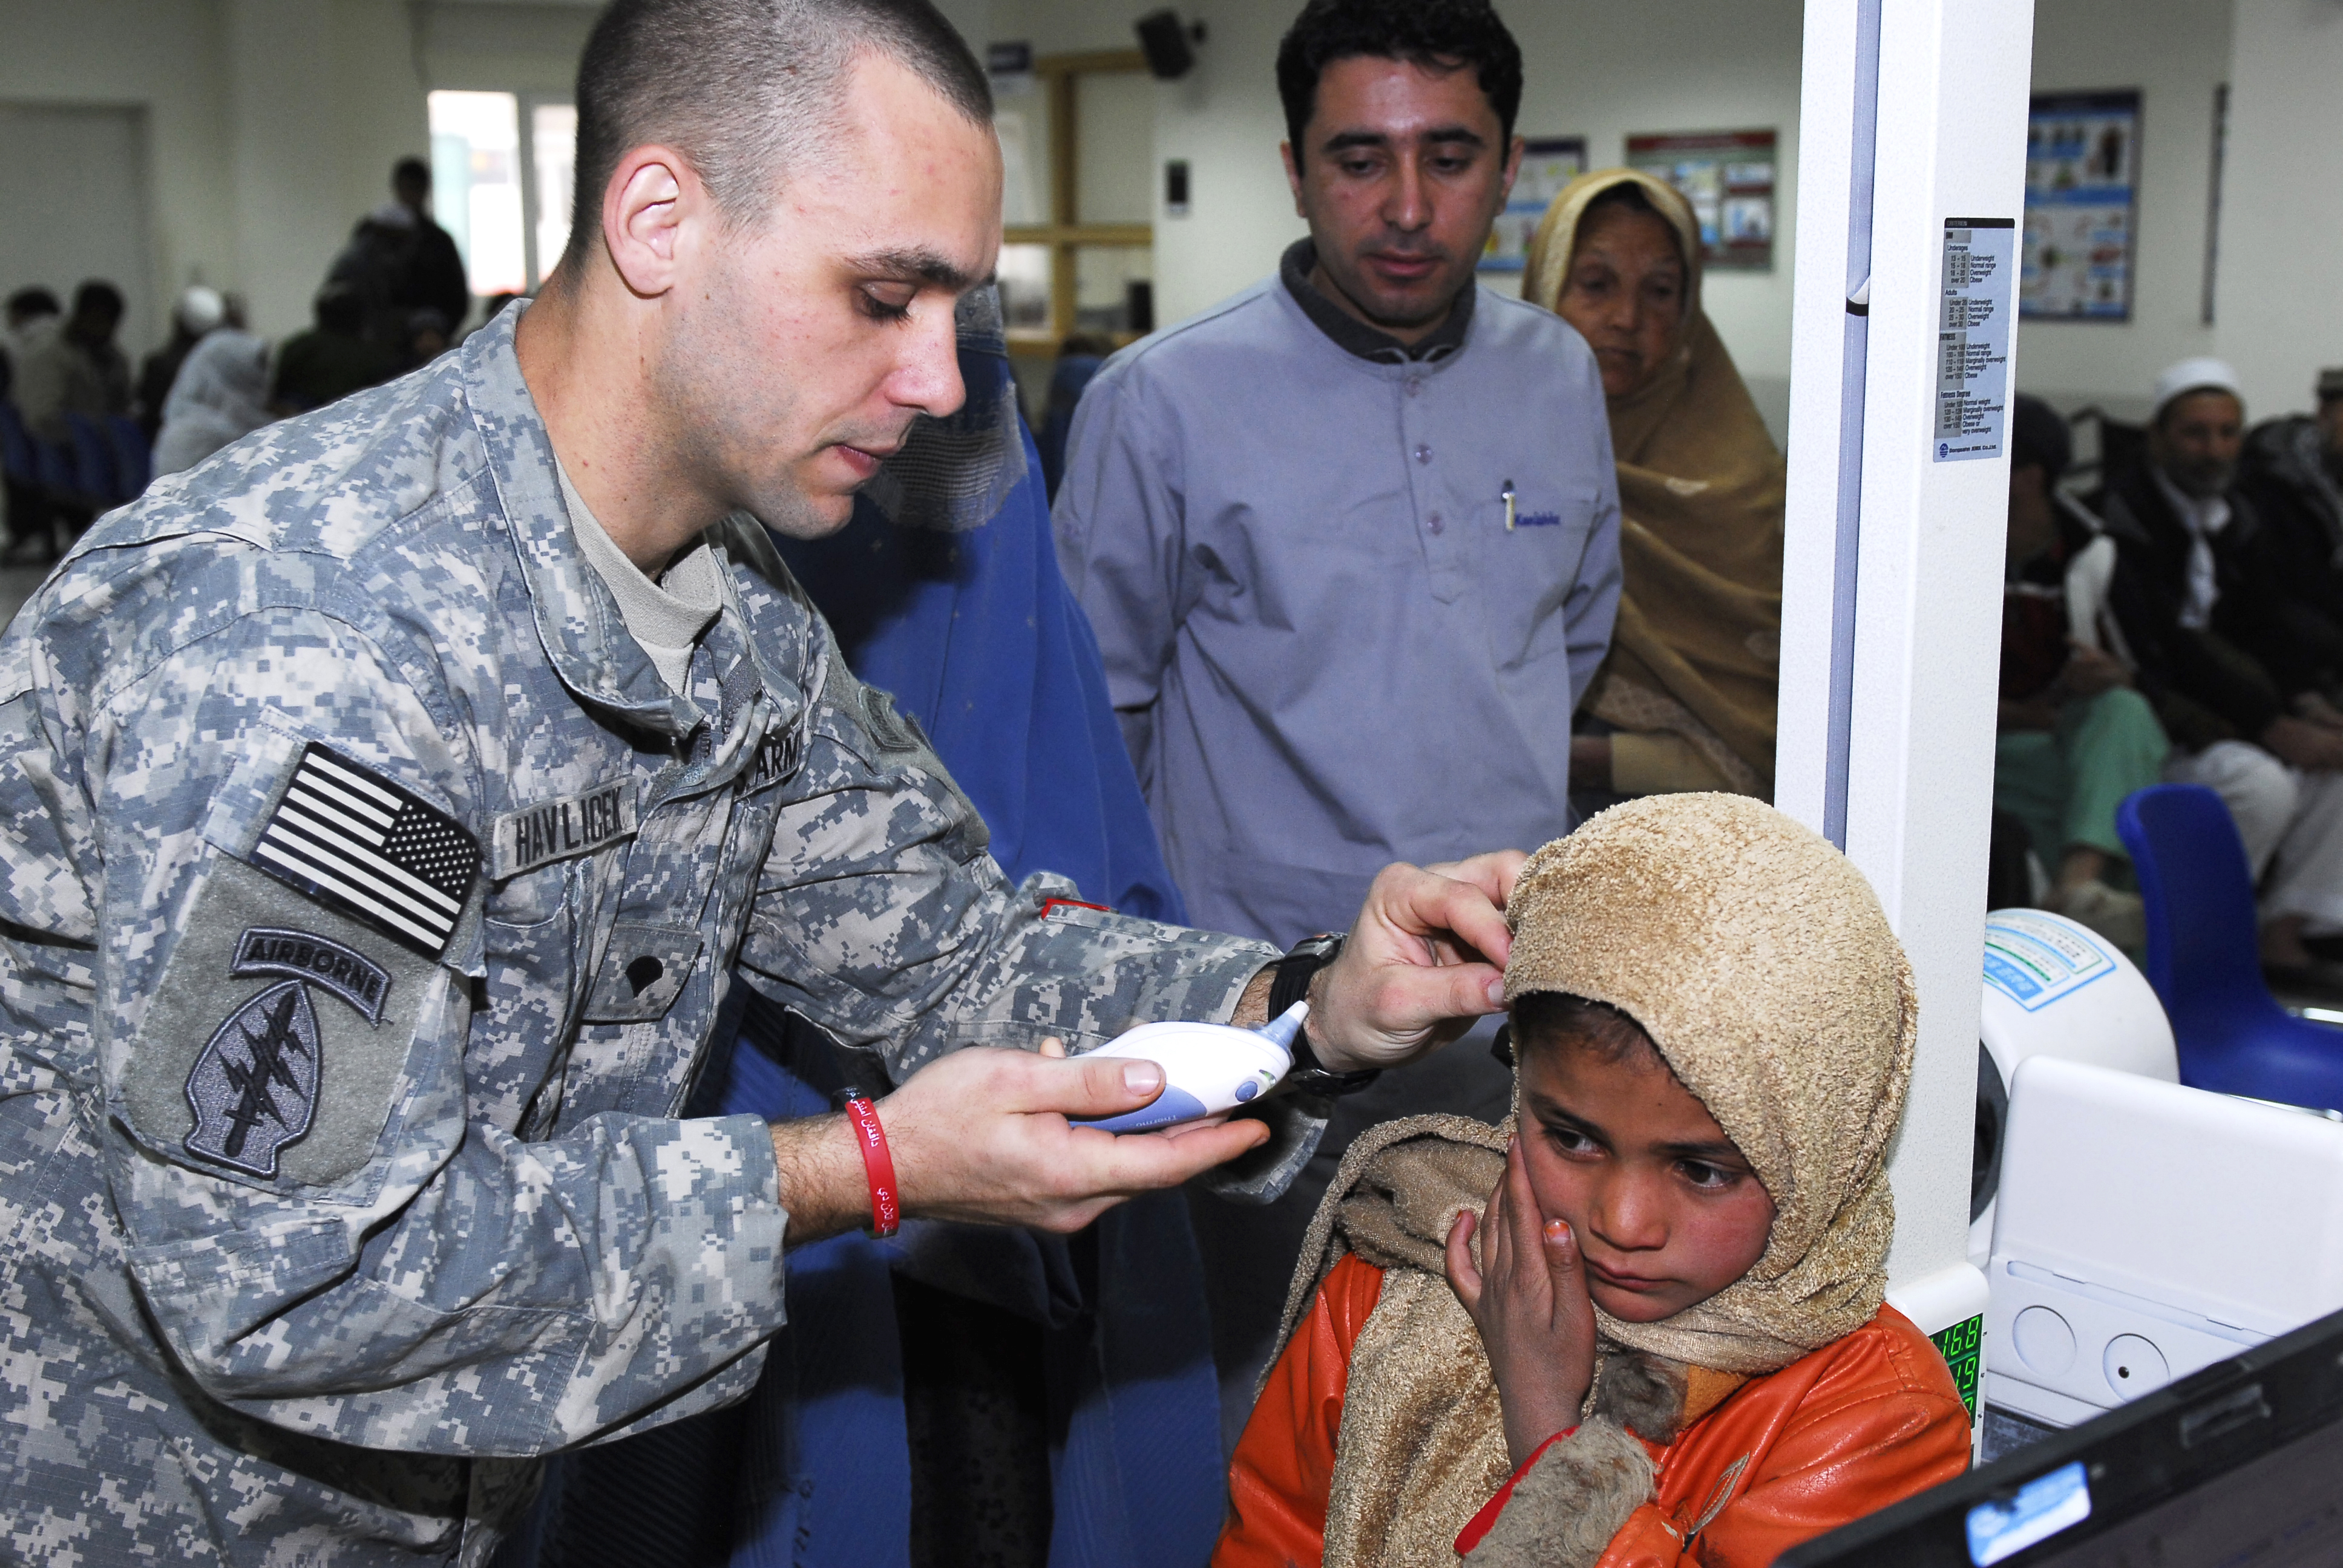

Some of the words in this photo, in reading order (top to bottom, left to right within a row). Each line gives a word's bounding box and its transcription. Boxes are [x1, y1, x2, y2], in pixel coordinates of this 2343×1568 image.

[754, 730, 802, 786] ARM
[516, 786, 623, 866] HAVLICEK
[244, 937, 382, 1005] AIRBORNE
